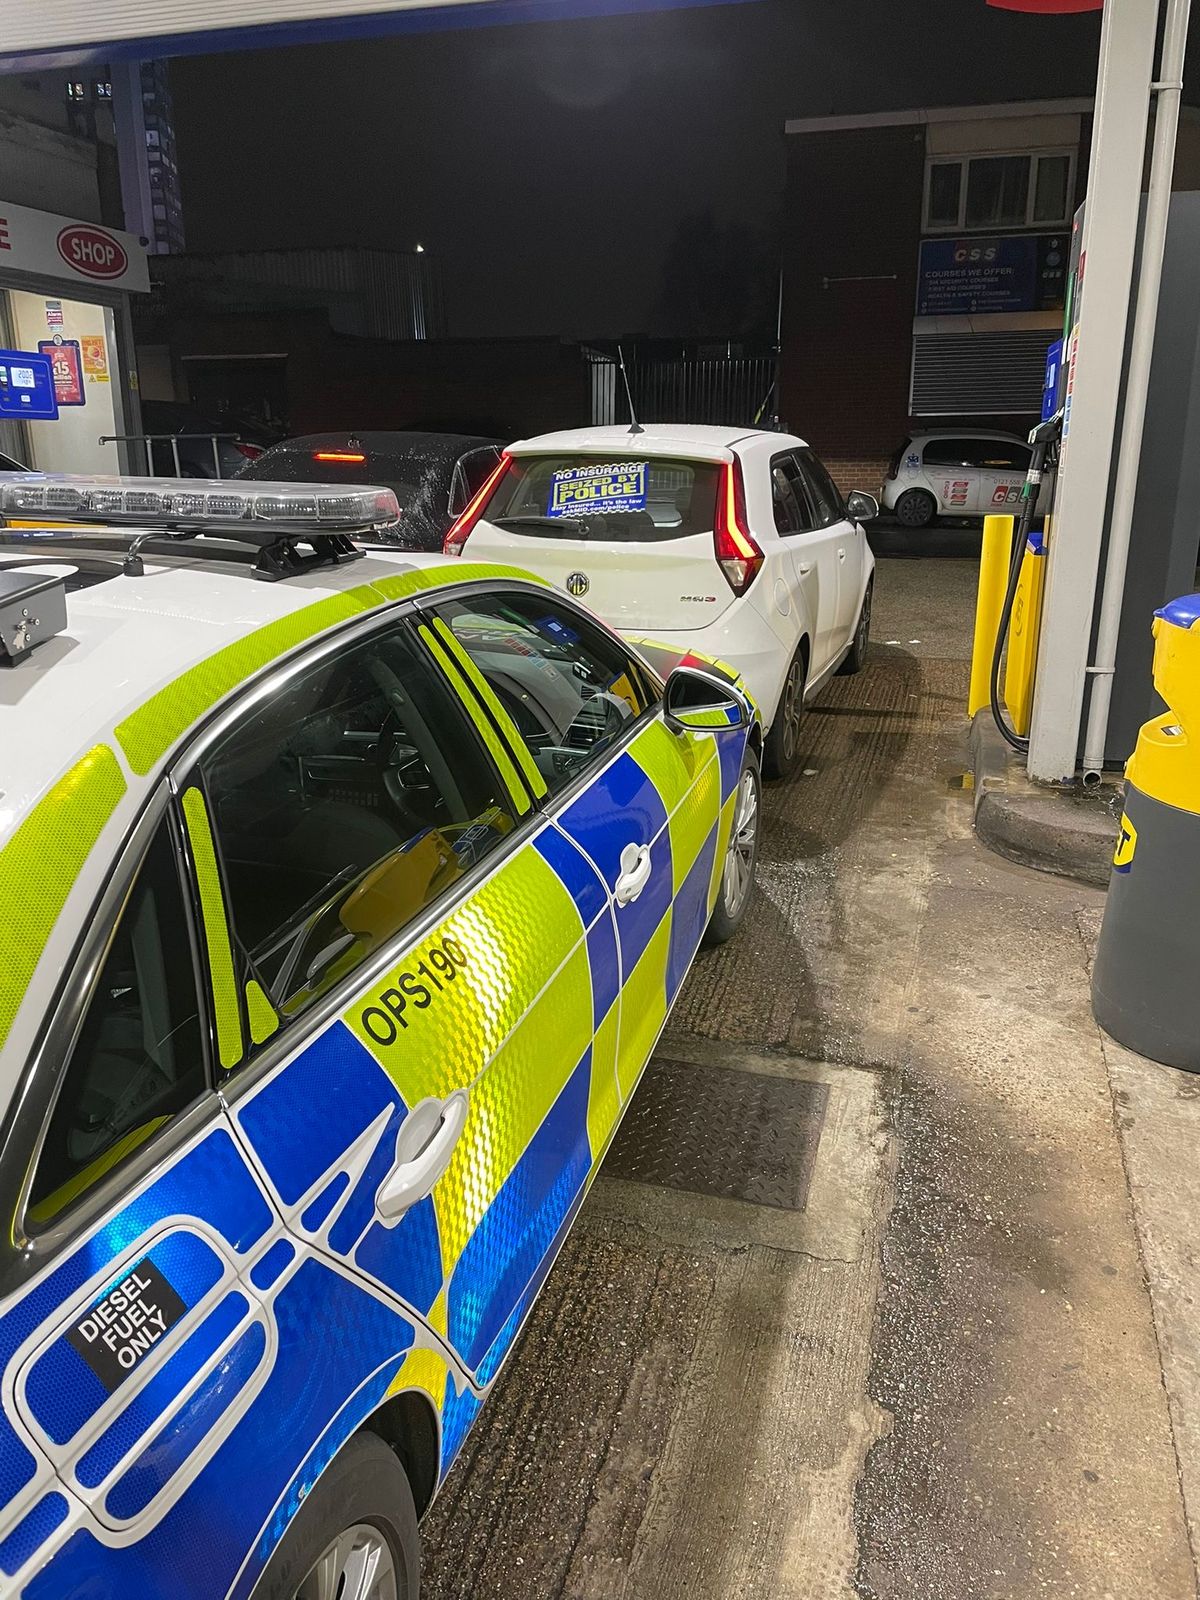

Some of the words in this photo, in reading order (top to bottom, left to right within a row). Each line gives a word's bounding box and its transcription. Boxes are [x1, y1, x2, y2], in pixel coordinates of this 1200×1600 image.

[71, 237, 115, 266] SHOP
[955, 248, 996, 262] CSS
[925, 269, 966, 279] COURSES
[968, 268, 983, 276] WE
[555, 471, 574, 481] NO
[575, 465, 645, 478] INSURANCE
[559, 476, 612, 492] SEIZED
[618, 472, 639, 482] BY
[559, 481, 637, 503] POLICE
[361, 937, 467, 1046] OPS190
[77, 1273, 152, 1343] DIESEL
[101, 1298, 157, 1352] FUEL
[117, 1308, 167, 1369] ONLY
